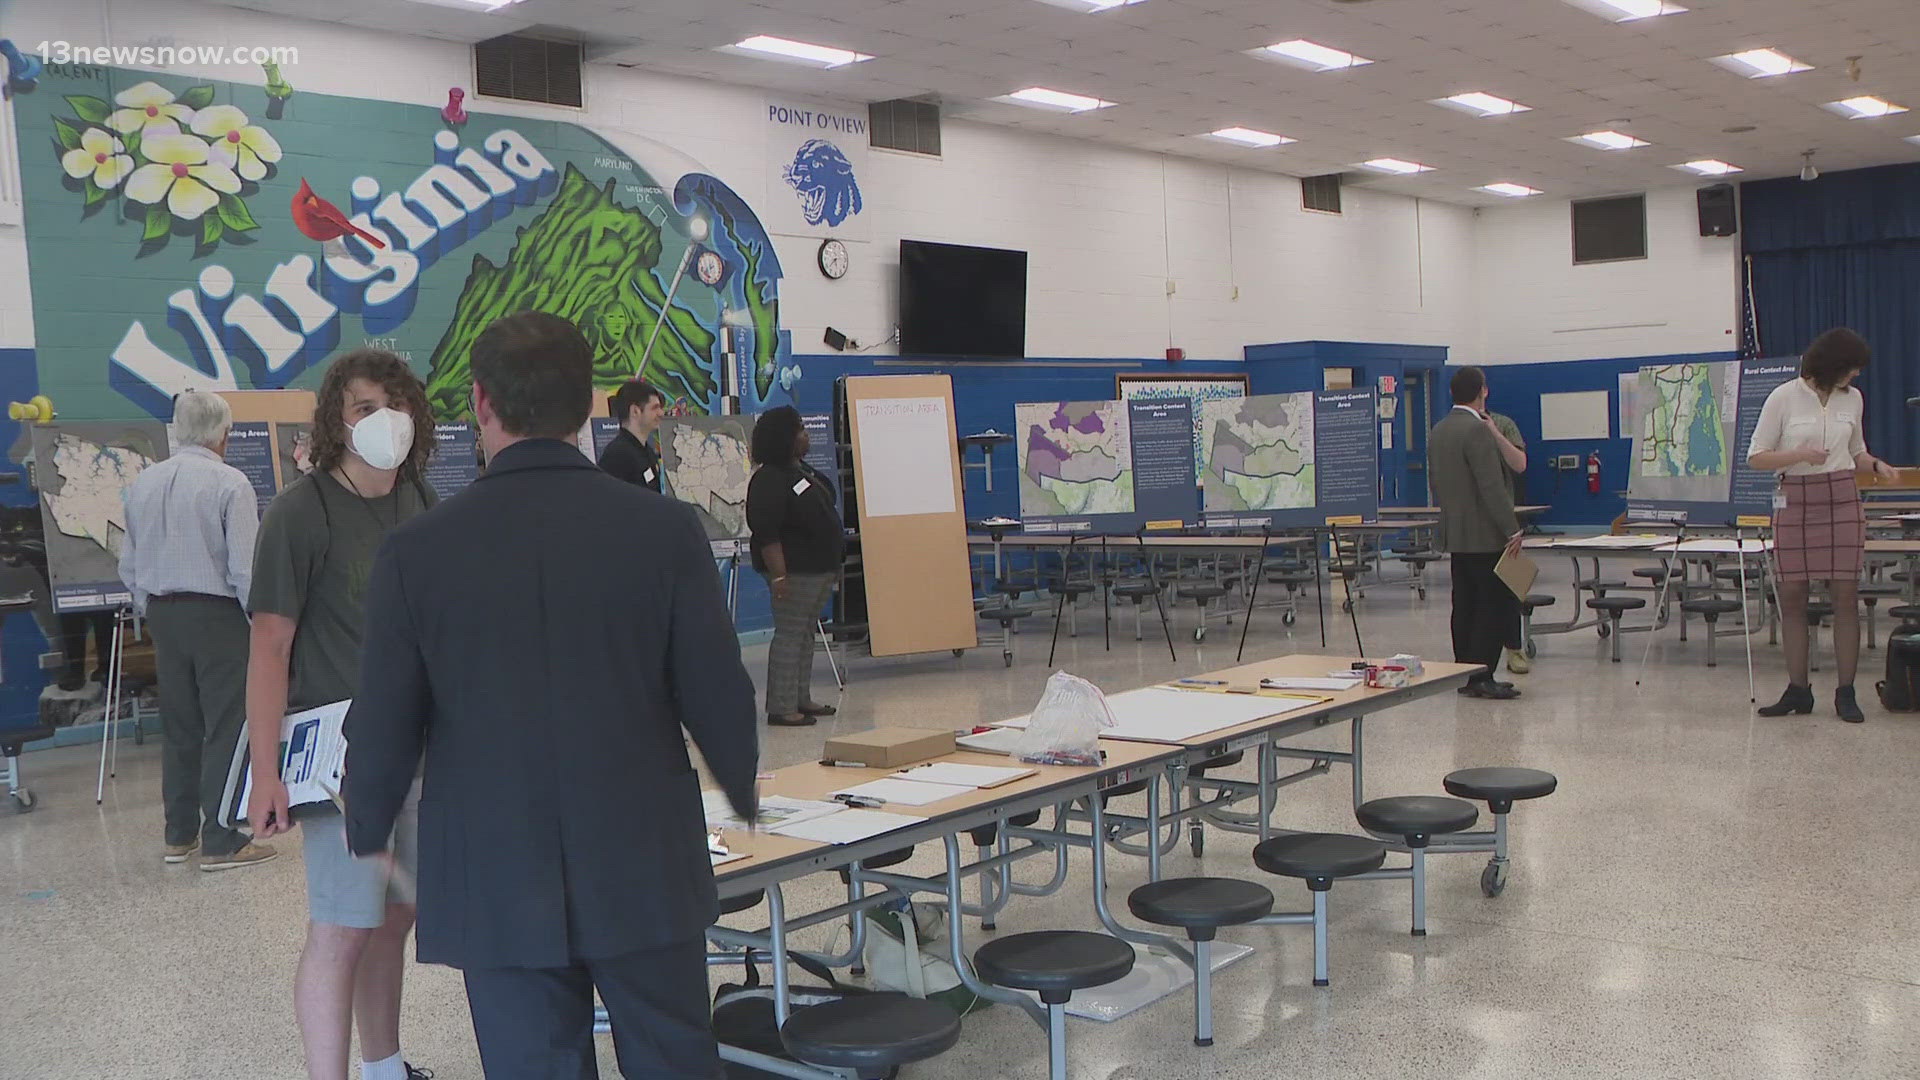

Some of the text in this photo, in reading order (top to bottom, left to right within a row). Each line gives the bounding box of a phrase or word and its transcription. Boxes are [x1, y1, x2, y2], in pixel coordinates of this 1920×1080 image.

[769, 105, 866, 134] POINT O'VIEW
[593, 157, 633, 171] MARYLAND
[109, 128, 558, 394] Virginia
[738, 328, 746, 342] Bay
[363, 338, 397, 351] WEST
[1744, 367, 1760, 375] Rural
[1318, 392, 1371, 402] Transition Context
[864, 403, 941, 417] TRANSITION AREA
